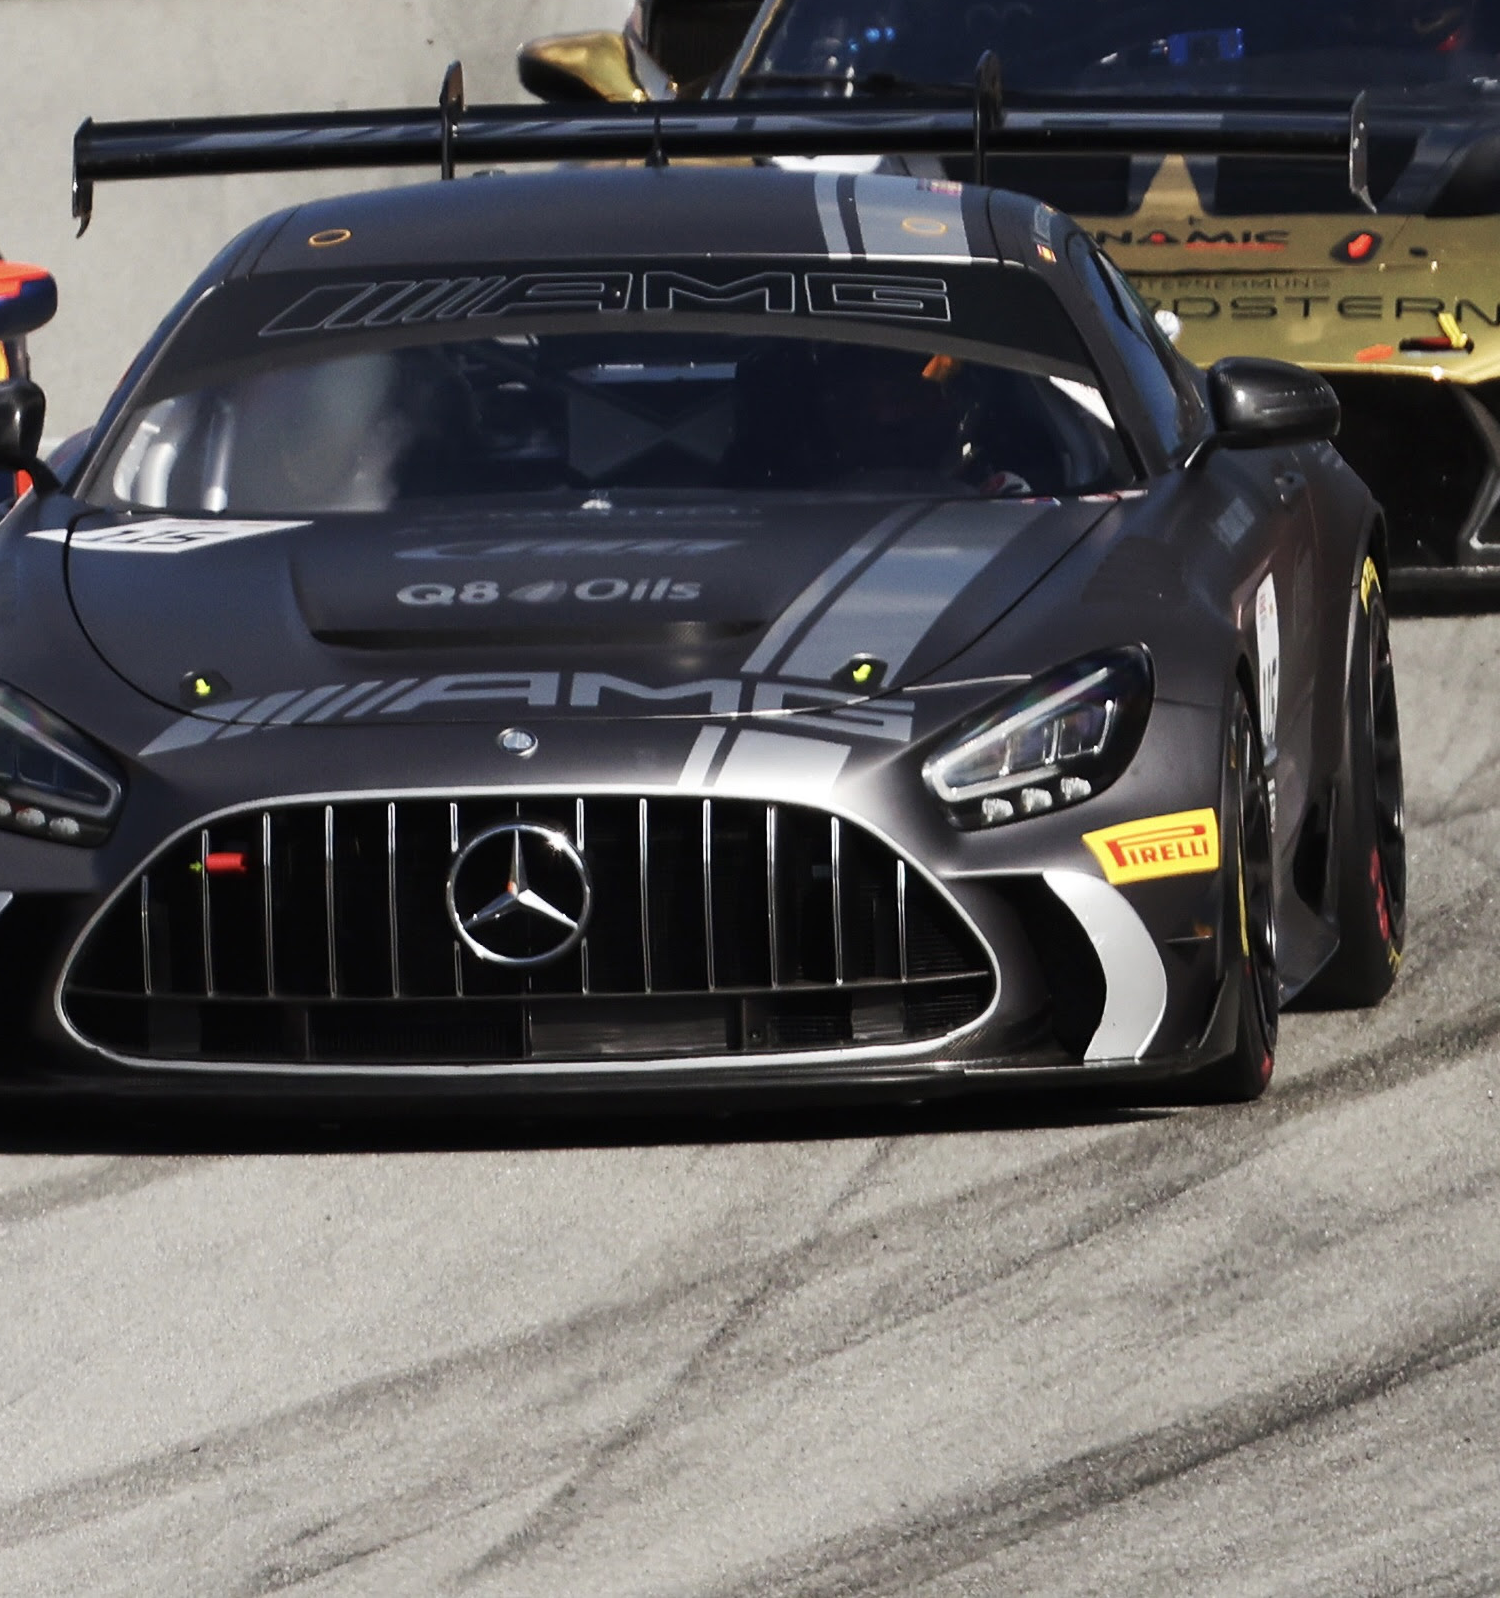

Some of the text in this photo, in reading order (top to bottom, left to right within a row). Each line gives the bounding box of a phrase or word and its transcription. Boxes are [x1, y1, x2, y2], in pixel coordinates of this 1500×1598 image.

[396, 576, 702, 606] Q8 Oils
[1103, 824, 1210, 868] PIRELLI
